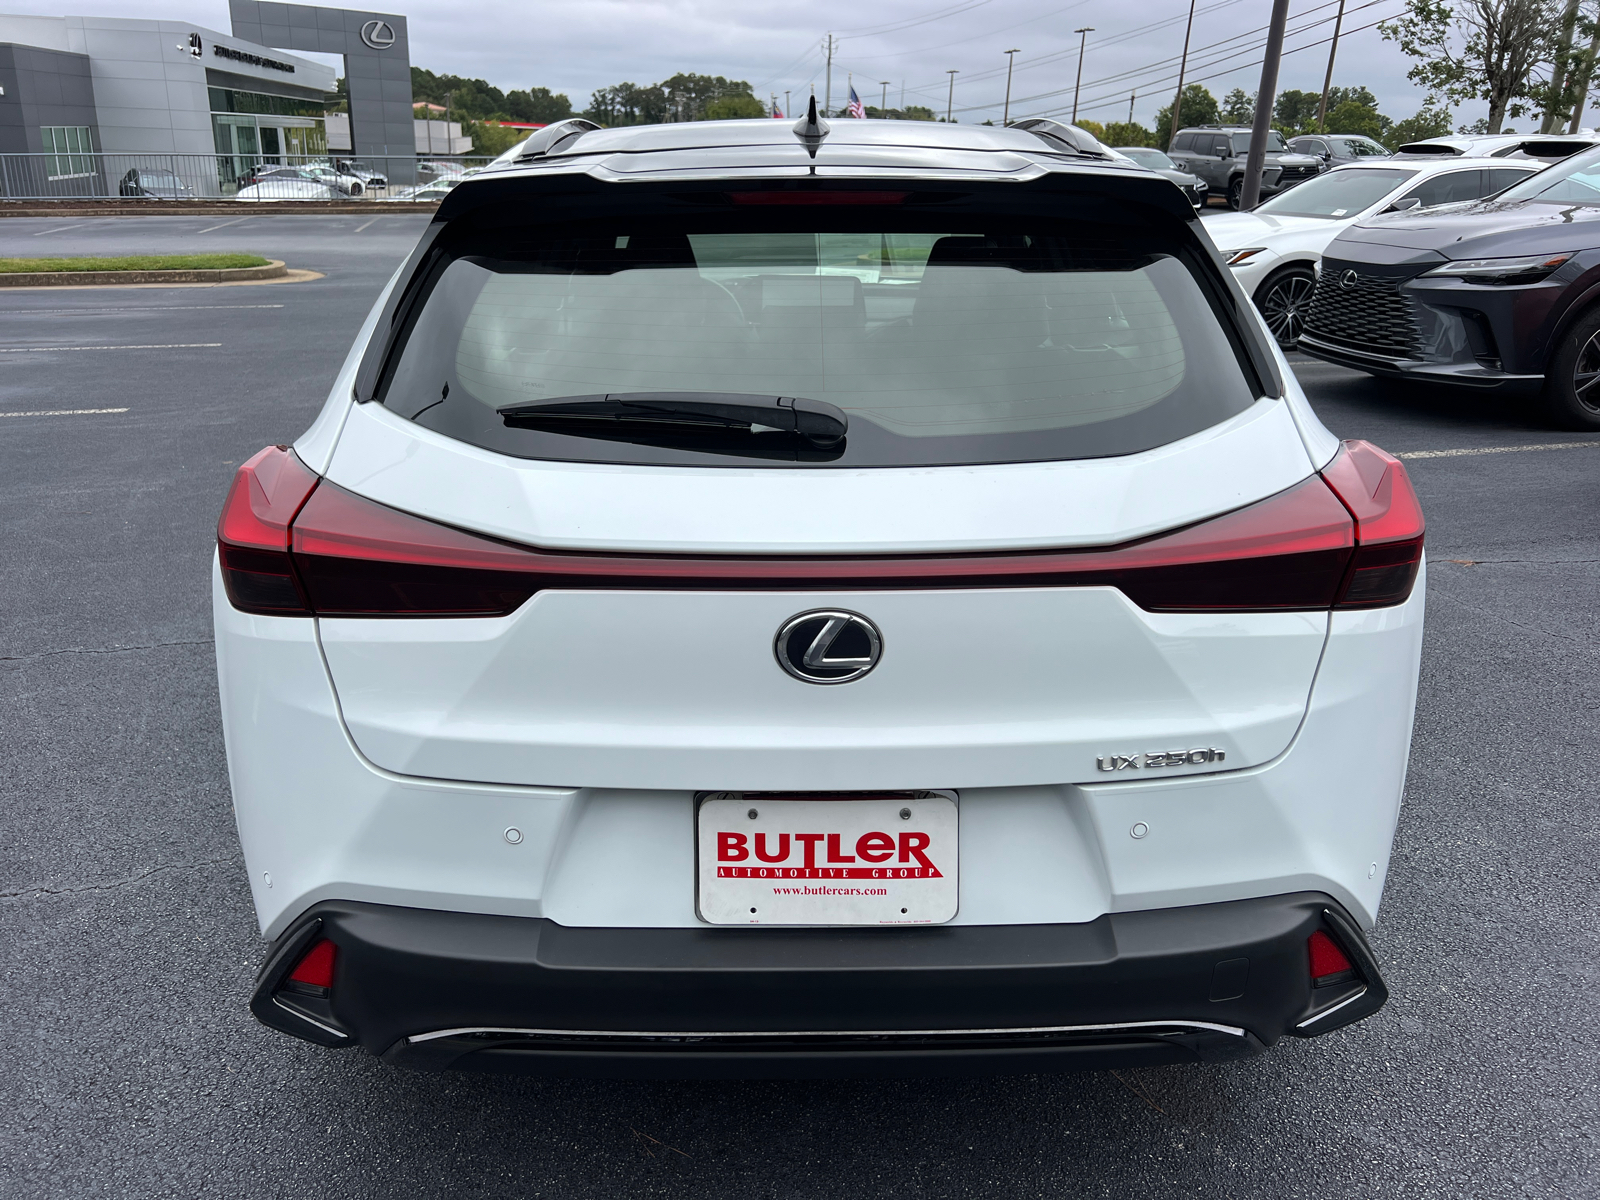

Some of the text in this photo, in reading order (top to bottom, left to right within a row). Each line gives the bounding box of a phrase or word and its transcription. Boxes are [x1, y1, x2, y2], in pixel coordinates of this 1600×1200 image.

[1097, 747, 1226, 772] UX 250h
[718, 867, 935, 878] AUTOMOTIVE GROUP
[773, 885, 888, 896] www.butlercars.com
